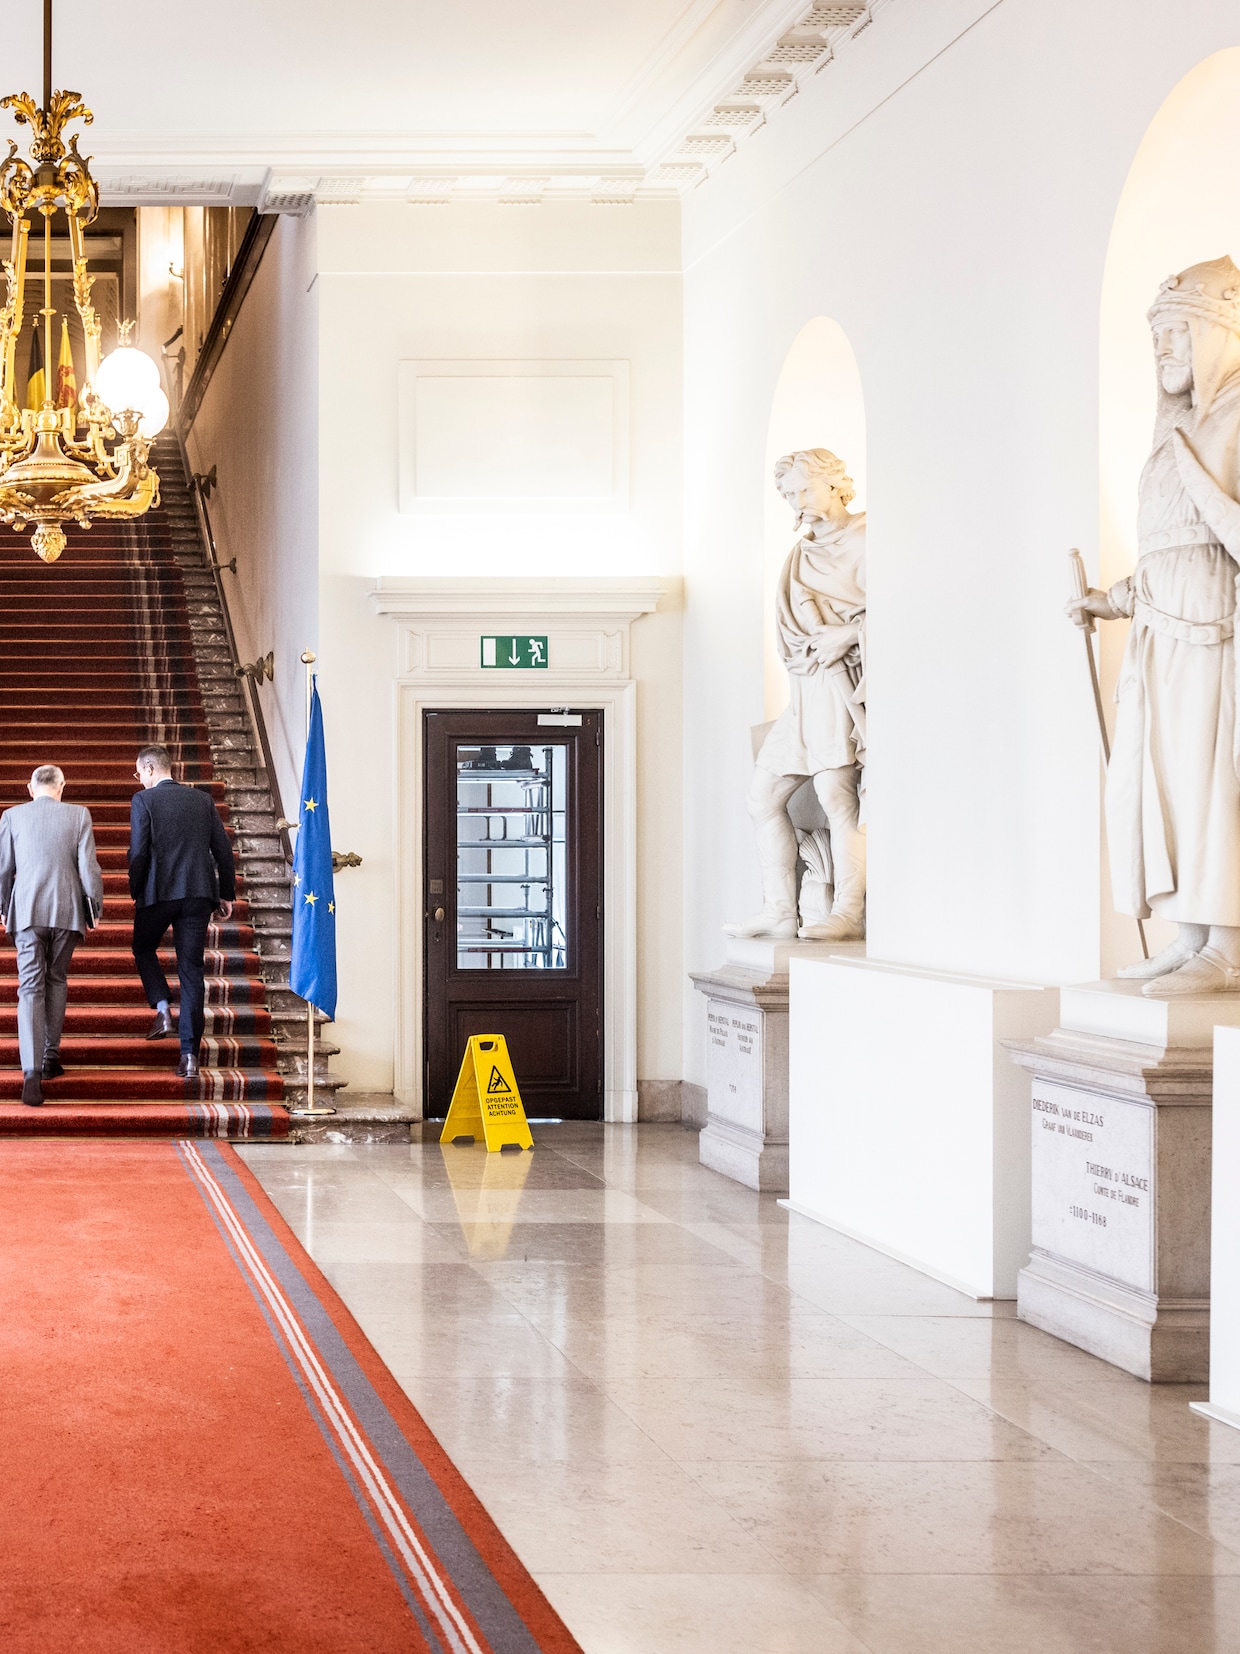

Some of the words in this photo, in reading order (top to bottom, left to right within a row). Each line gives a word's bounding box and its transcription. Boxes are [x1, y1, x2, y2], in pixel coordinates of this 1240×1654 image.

[1032, 1098, 1059, 1116] DIEDERIK
[1081, 1111, 1104, 1128] ELZAS
[1086, 1161, 1112, 1181] THIERRY
